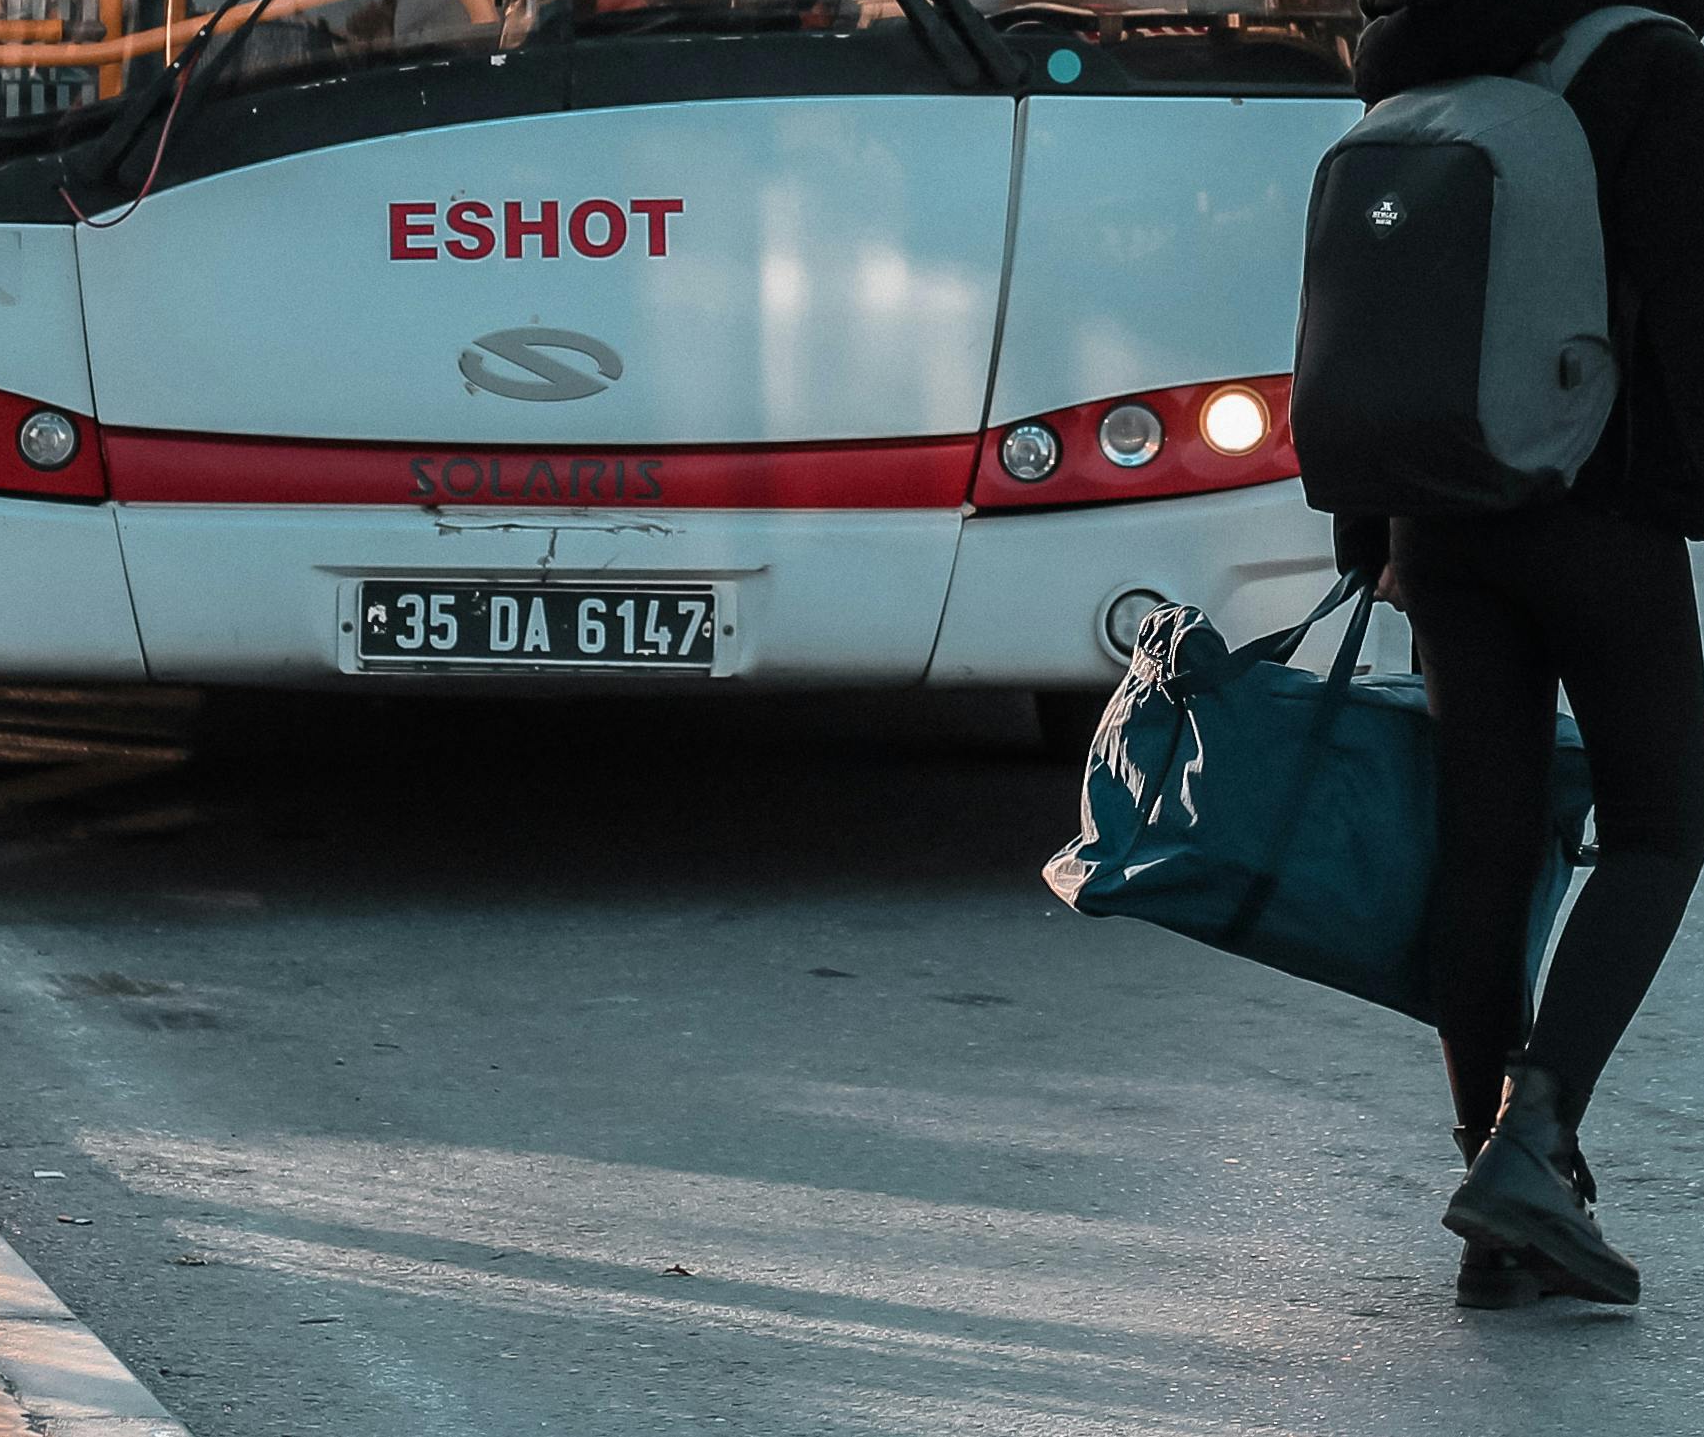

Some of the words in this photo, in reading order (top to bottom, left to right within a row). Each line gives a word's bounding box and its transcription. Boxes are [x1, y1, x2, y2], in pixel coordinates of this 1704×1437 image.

[387, 197, 685, 262] ESHOT
[408, 457, 663, 501] SOLARIS
[396, 594, 458, 651] 35
[489, 596, 551, 652] DA
[577, 598, 707, 656] 6147
